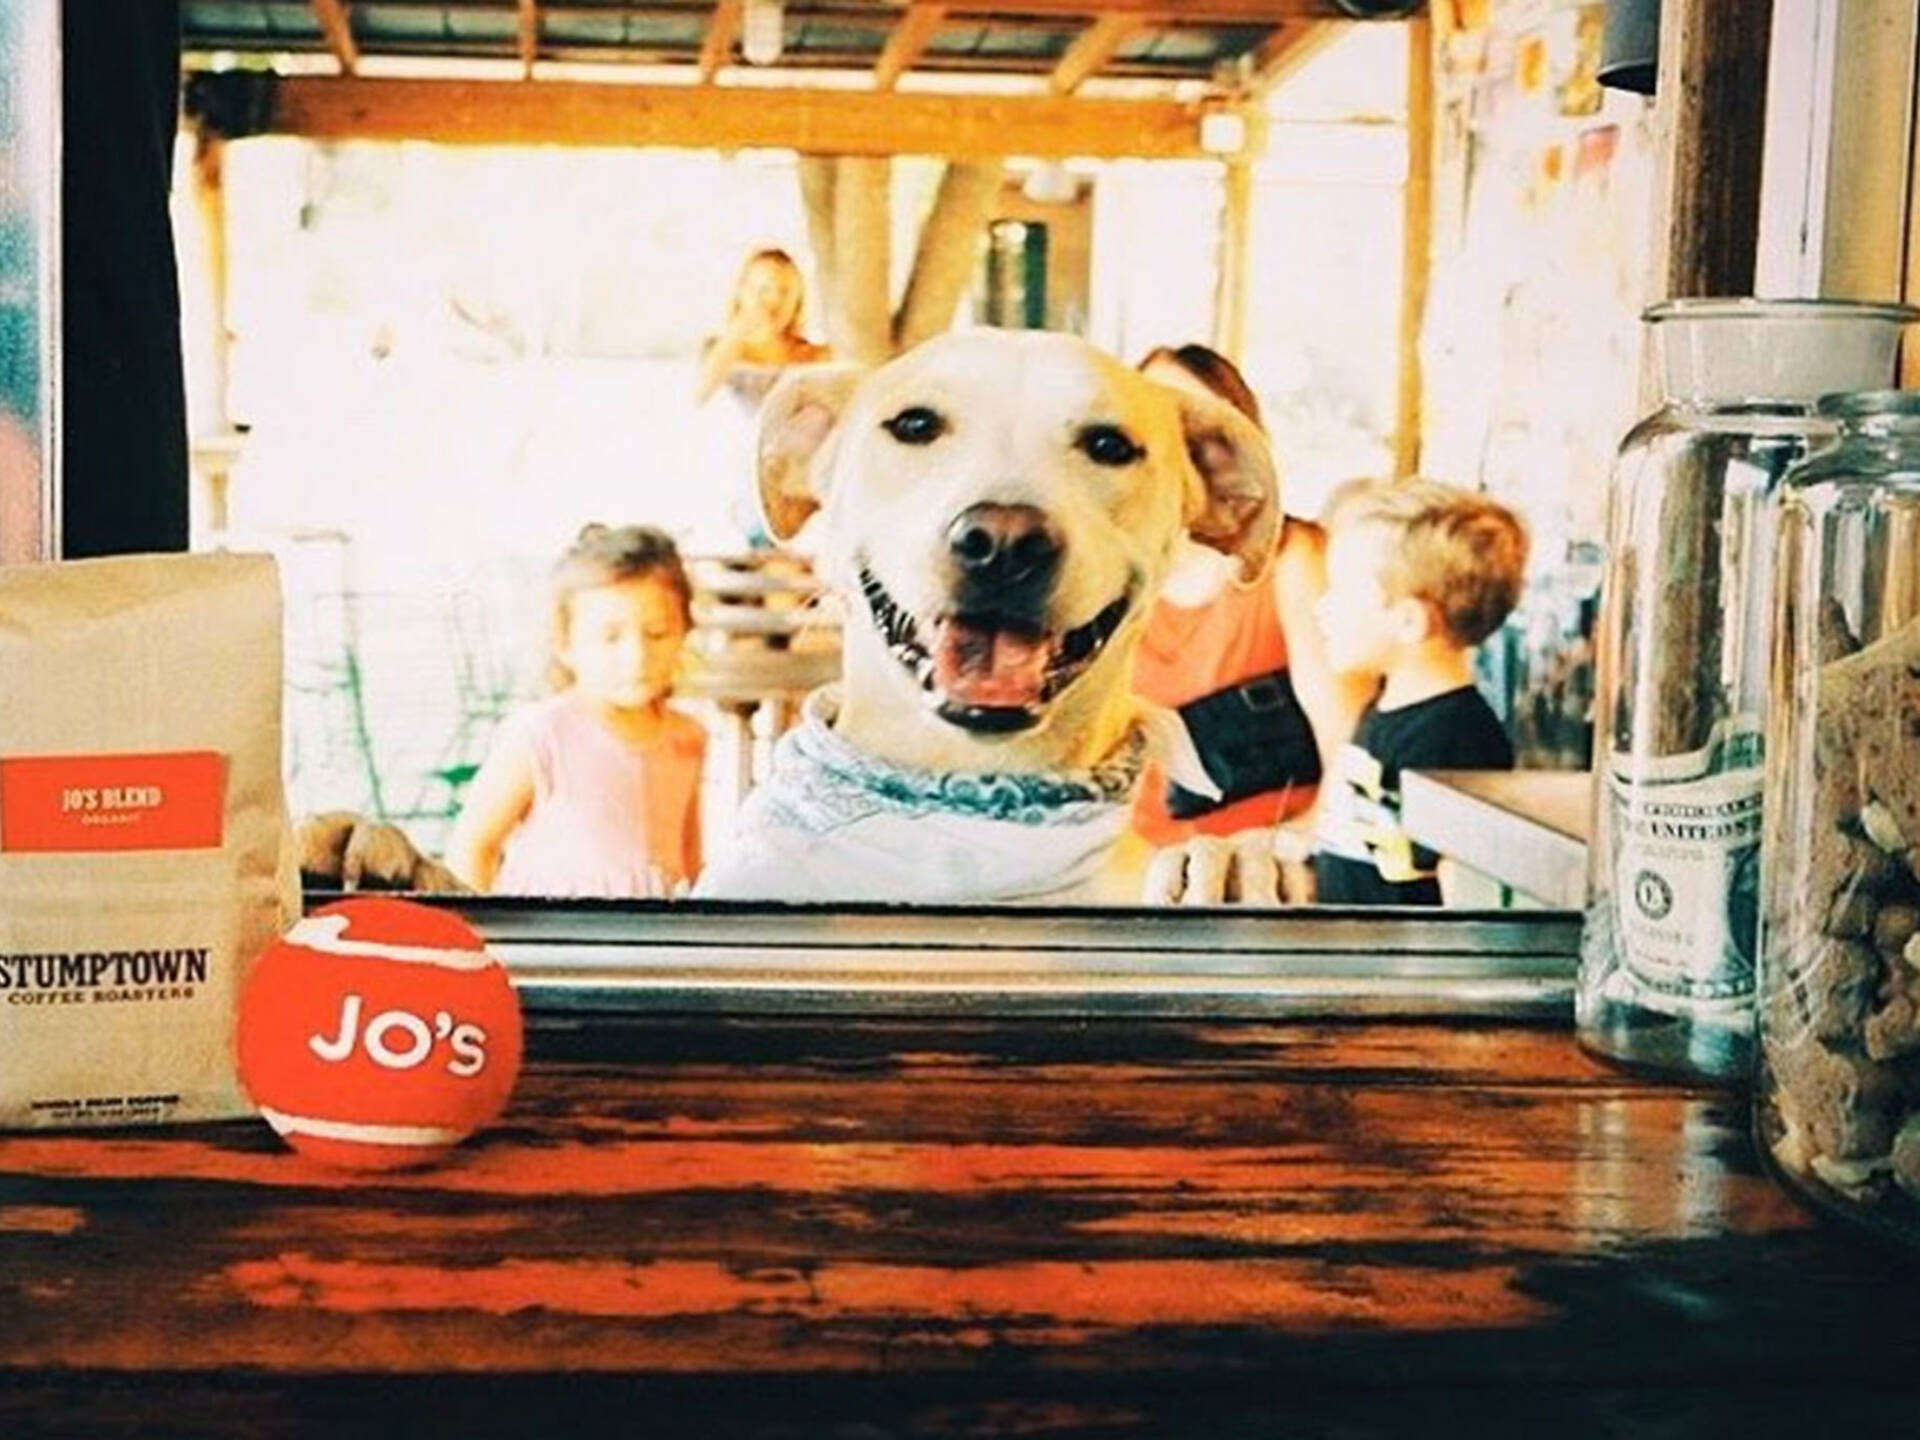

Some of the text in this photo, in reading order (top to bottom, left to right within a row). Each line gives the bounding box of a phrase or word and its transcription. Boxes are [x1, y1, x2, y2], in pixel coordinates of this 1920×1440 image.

[0, 949, 207, 988] STUMPTOWN
[8, 986, 194, 1005] COFFEE ROASTERS
